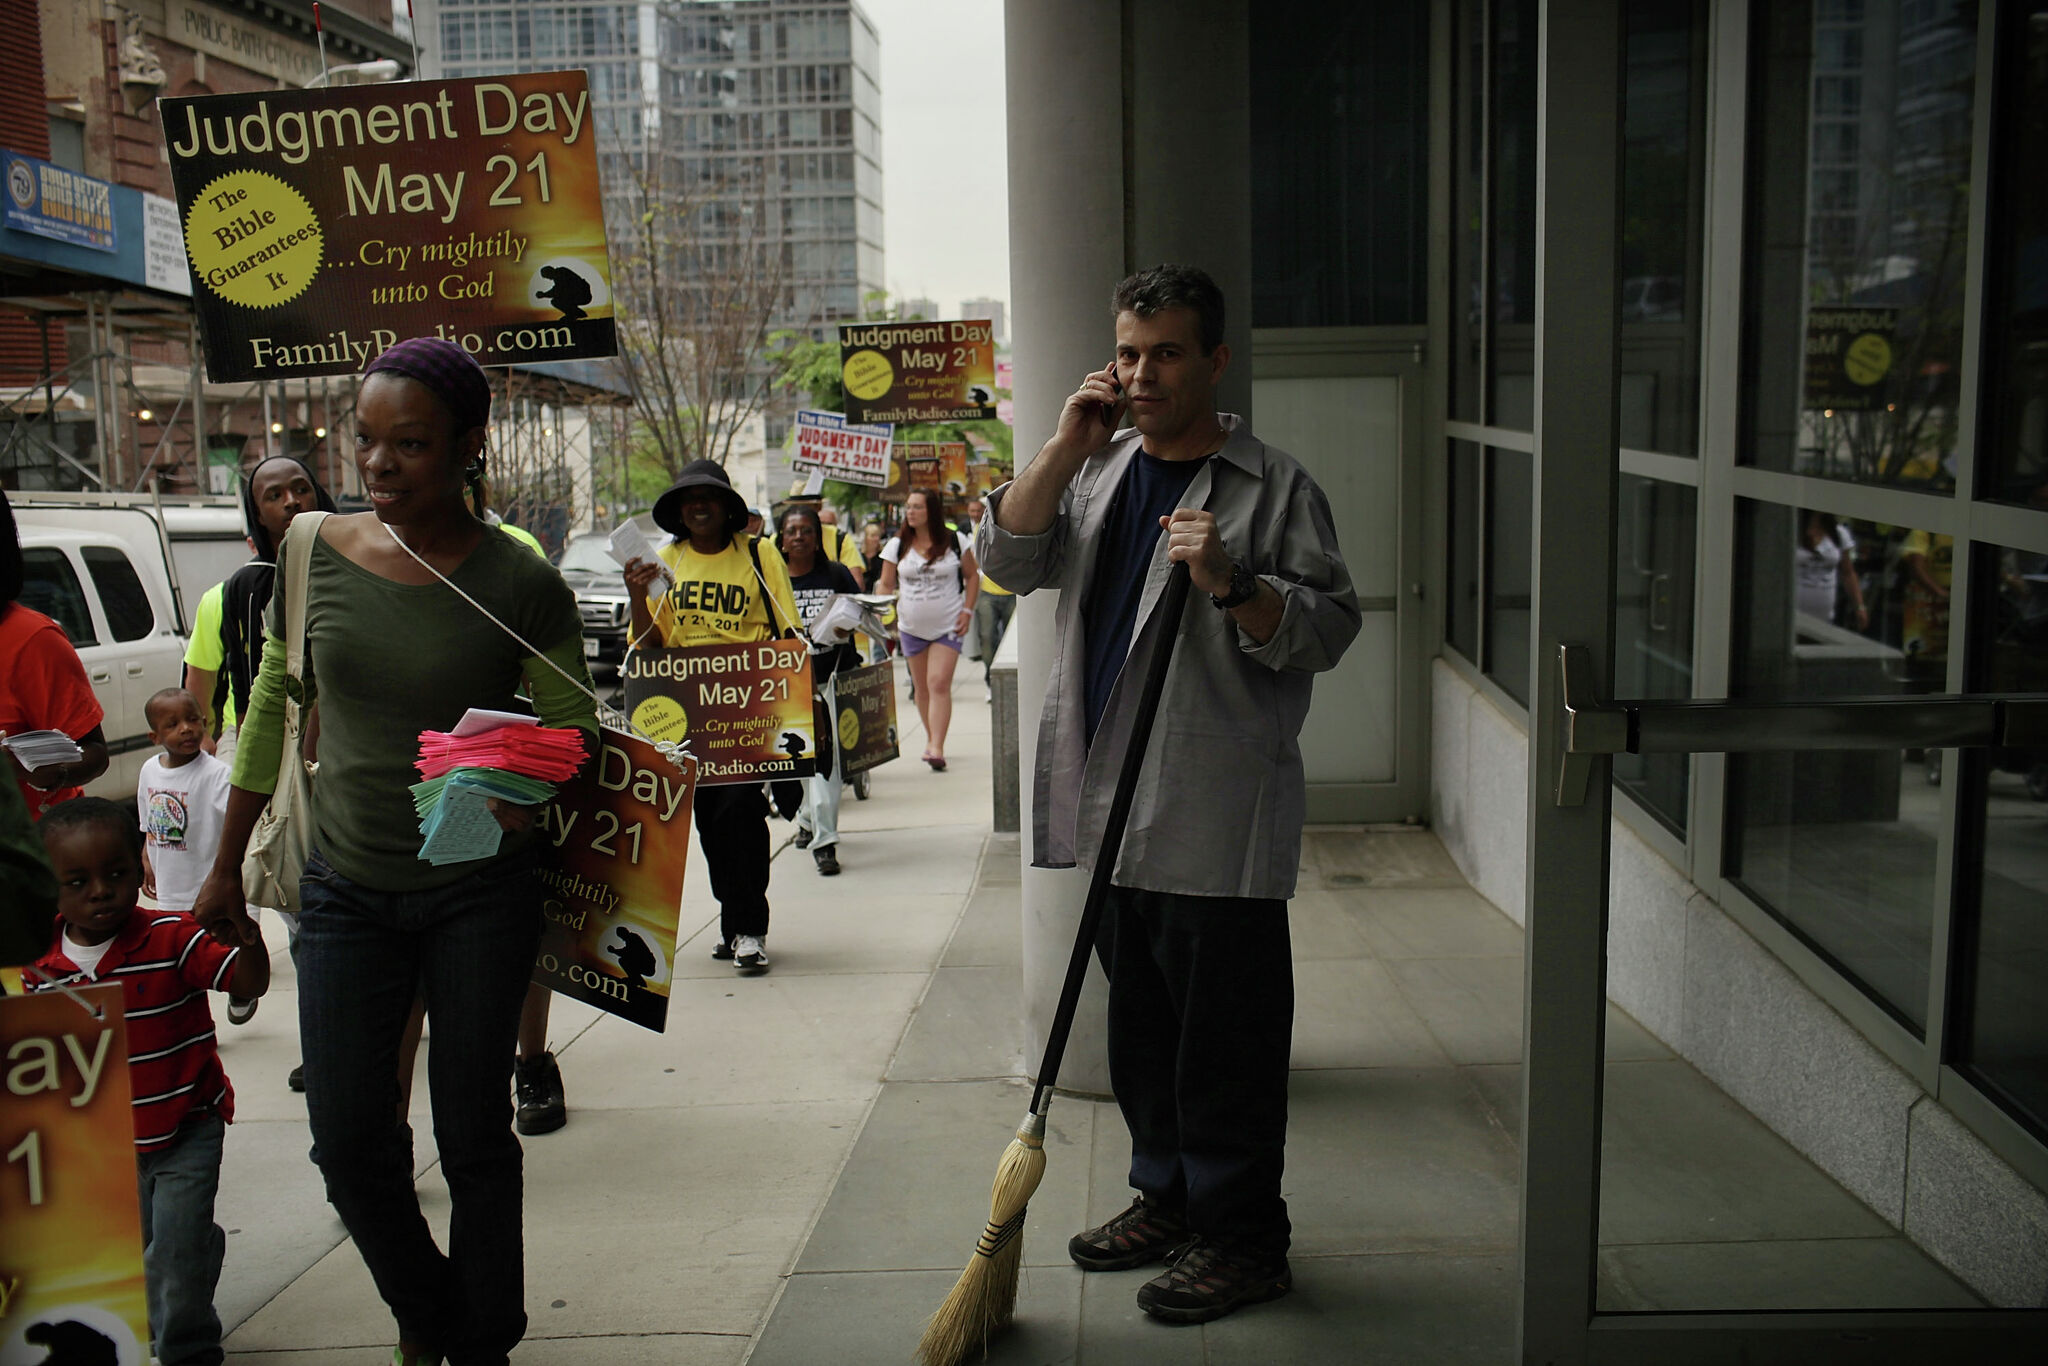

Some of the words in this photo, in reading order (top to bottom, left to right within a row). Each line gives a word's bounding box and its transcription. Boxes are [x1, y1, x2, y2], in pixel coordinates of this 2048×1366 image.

[173, 93, 458, 164] Judgment
[474, 82, 589, 144] Day
[40, 166, 71, 188] BUILD
[342, 163, 466, 224] May
[488, 153, 552, 207] 21
[41, 183, 72, 205] BUILD
[208, 187, 248, 213] The
[42, 199, 73, 222] BUILD
[212, 209, 276, 250] Bible
[207, 223, 318, 287] Guarantees
[420, 233, 528, 270] mightily
[265, 271, 288, 291] It
[371, 281, 429, 306] unto
[438, 272, 495, 300] God
[249, 324, 576, 371] FamilyRdio.com
[841, 325, 946, 350] Judgment
[951, 322, 992, 345] Day
[901, 349, 947, 373] May
[952, 347, 978, 367] 21
[862, 406, 983, 424] FamilyRadio.com
[798, 427, 863, 452] JUDGMENT
[864, 437, 888, 455] DAY
[800, 445, 828, 465] May
[832, 450, 850, 468] 21,
[853, 454, 883, 470] 2011
[668, 581, 700, 613] HE
[700, 581, 750, 618] END;
[691, 615, 711, 630] 21,
[628, 650, 750, 682] Judgment
[758, 647, 807, 673] Day
[699, 681, 752, 709] May
[760, 677, 789, 702] 21
[861, 695, 880, 713] May
[642, 702, 659, 714] The
[643, 711, 670, 728] Bible
[651, 717, 686, 738] arantees
[732, 714, 781, 732] mightily
[709, 738, 735, 749] unto
[739, 733, 765, 747] God
[598, 744, 687, 822] Day
[697, 760, 795, 781] yRadio.com
[535, 803, 579, 848] ay
[590, 809, 643, 865] 21
[543, 899, 587, 932] God
[6, 1028, 113, 1108] ay
[6, 1130, 44, 1206] 1
